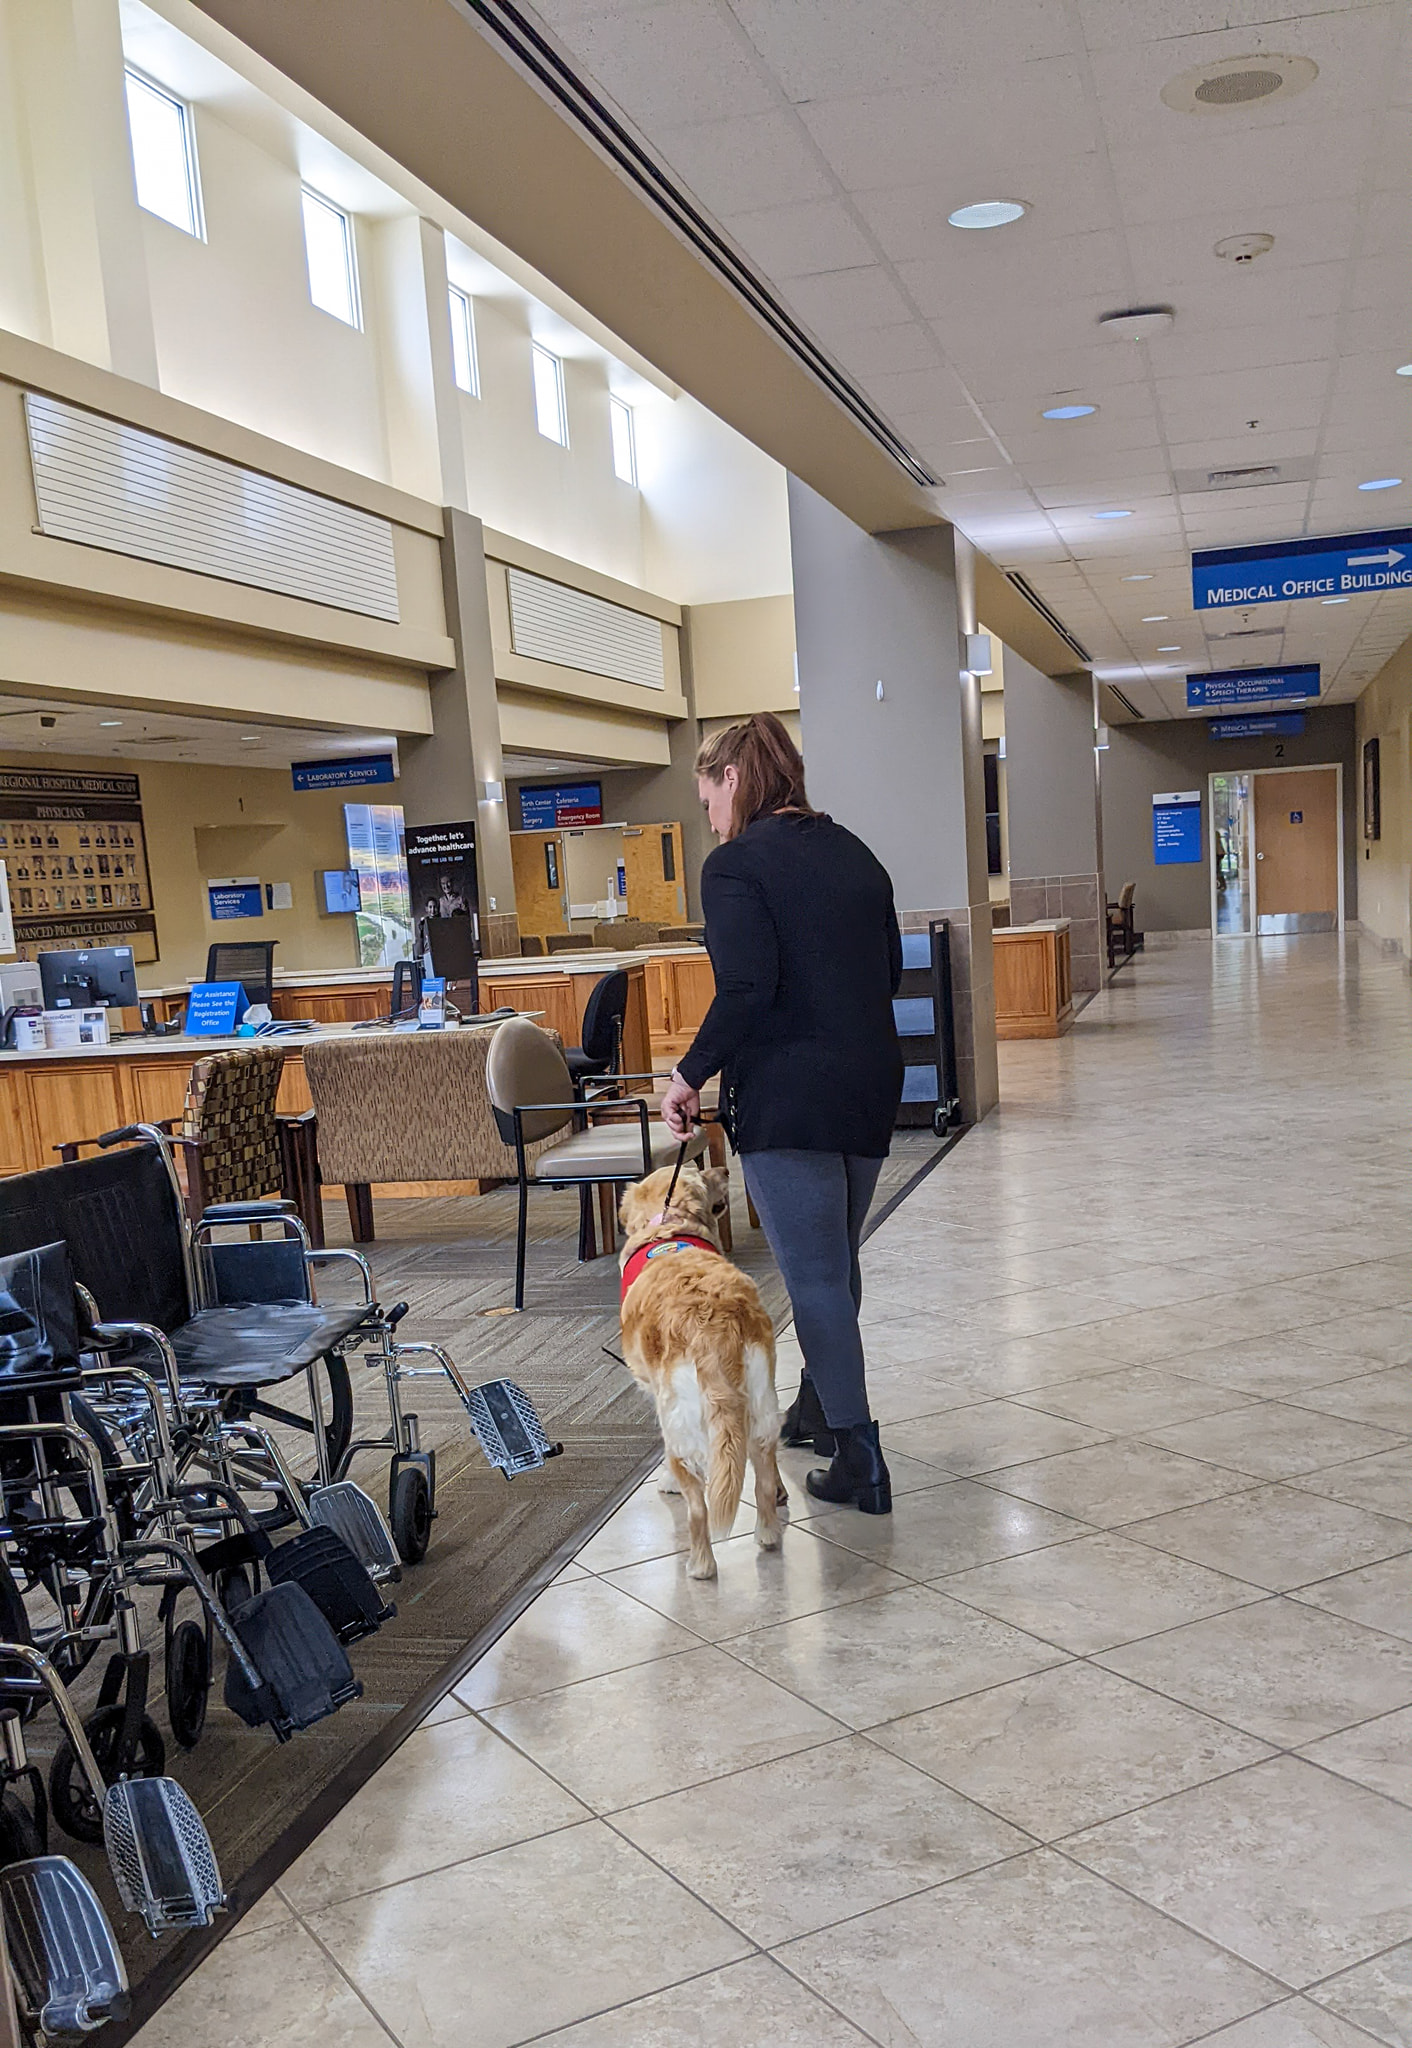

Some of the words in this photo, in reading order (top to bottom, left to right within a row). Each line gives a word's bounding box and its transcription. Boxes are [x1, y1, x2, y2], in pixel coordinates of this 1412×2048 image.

[1207, 585, 1277, 605] MEDICAL
[1282, 578, 1335, 596] OFFICE
[1340, 570, 1412, 590] BUILDING
[1211, 689, 1235, 697] SPEECH
[1236, 686, 1269, 694] THERAPIES
[1275, 745, 1284, 757] 2
[306, 771, 348, 782] LABORATORY
[349, 769, 378, 778] SERVICES
[41, 778, 80, 790] HOSPITAL
[81, 780, 115, 792] MEDICAL
[116, 781, 137, 792] STAFF
[36, 806, 85, 818] PHYSICIANS
[416, 834, 448, 845] Together,
[449, 832, 465, 840] let's
[408, 846, 437, 855] advance
[437, 842, 475, 852] healthcare
[213, 892, 246, 900] Laboratory
[14, 926, 53, 940] DVANCED
[55, 922, 94, 936] PRACTICE
[94, 920, 137, 933] CLINICIANS
[194, 1009, 230, 1018] Registration
